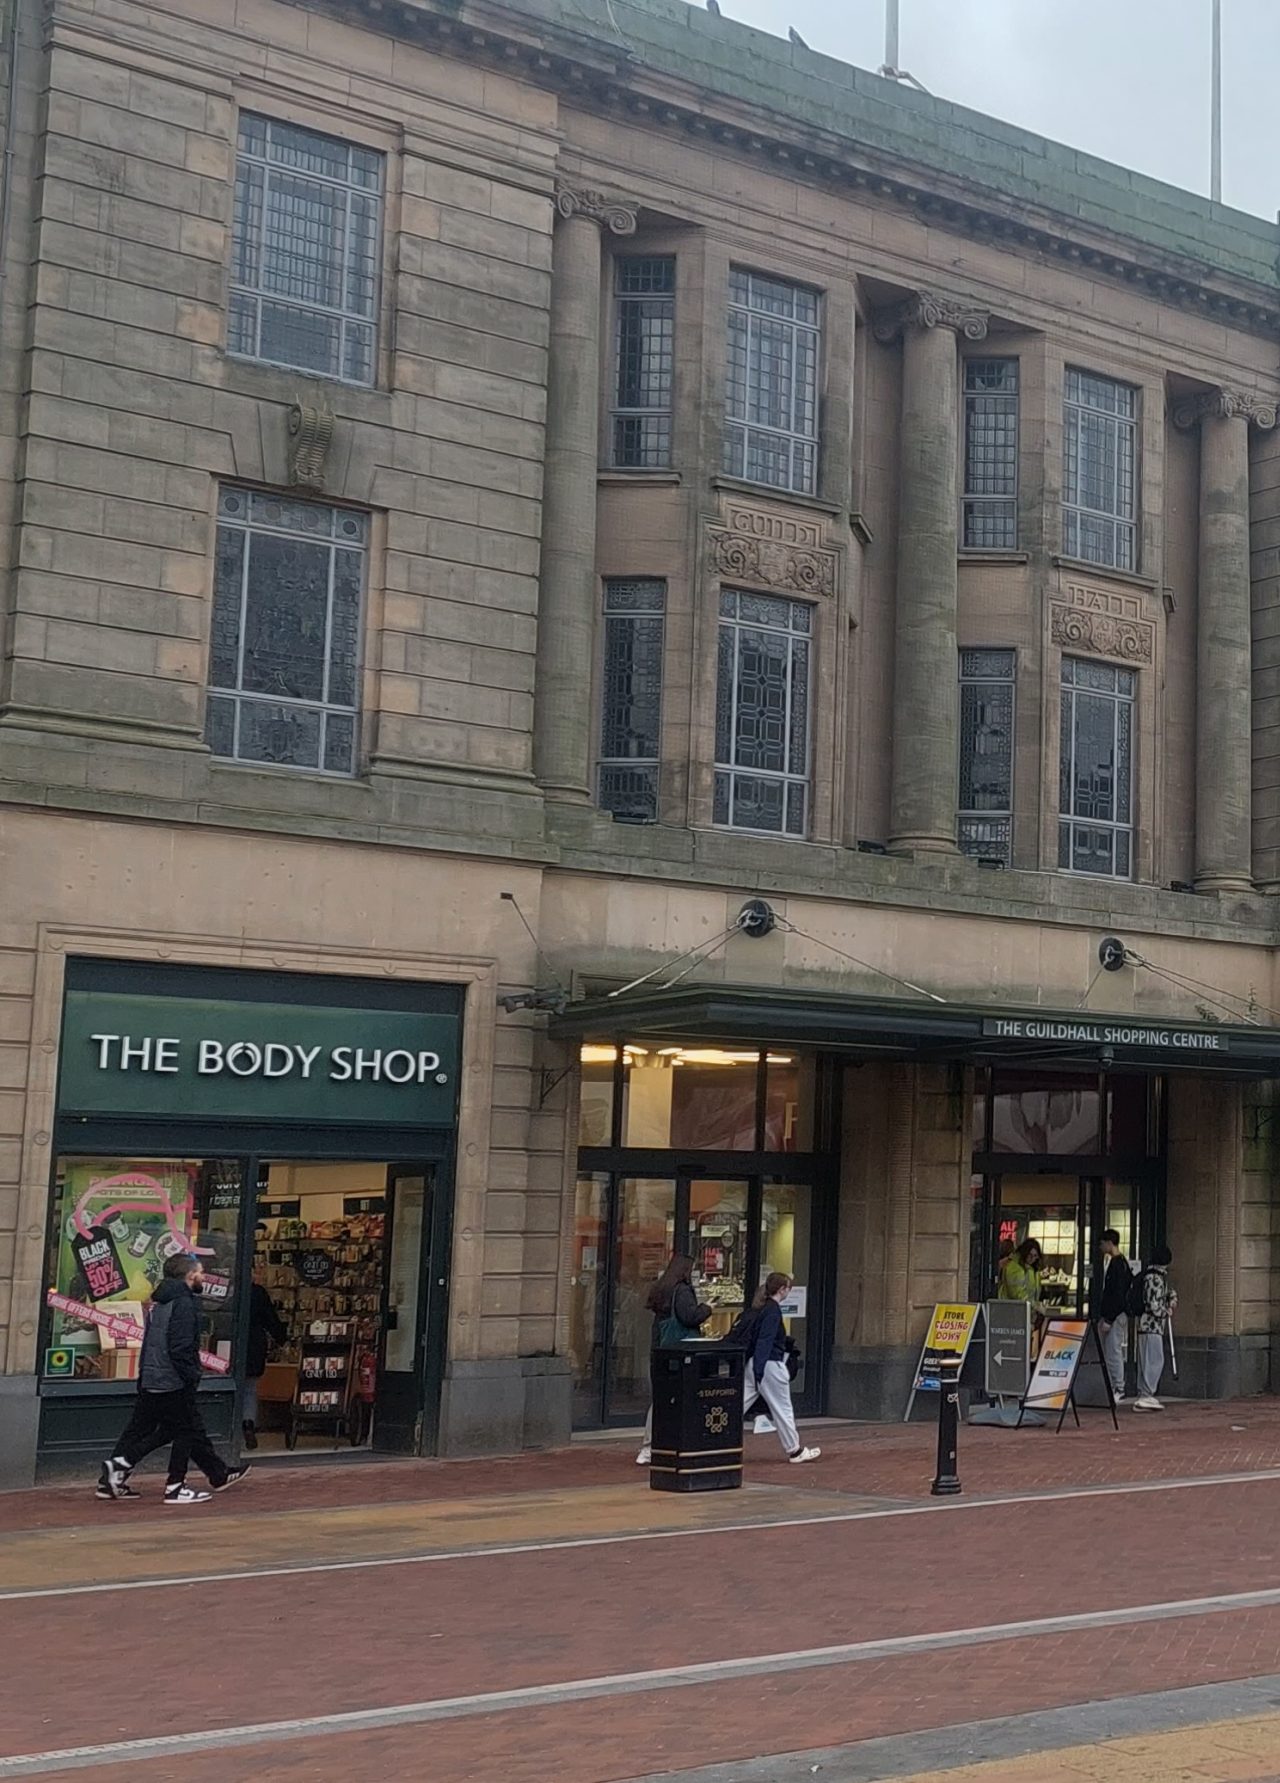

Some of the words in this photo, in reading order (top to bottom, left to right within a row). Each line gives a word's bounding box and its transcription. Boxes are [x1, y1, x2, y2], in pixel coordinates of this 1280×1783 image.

[734, 511, 811, 546] GUILD
[996, 1021, 1021, 1037] THE
[1026, 1022, 1100, 1042] GUILDHALL
[1104, 1027, 1169, 1047] SHOPPING
[1172, 1032, 1219, 1049] CENTRE
[91, 1034, 180, 1073] THE
[197, 1040, 322, 1078] BODY
[78, 1239, 111, 1261] BLACK
[87, 1258, 120, 1289] 50%
[92, 1278, 124, 1298] OFF
[935, 1320, 969, 1332] CLOSING
[943, 1311, 965, 1320] STORE
[935, 1331, 960, 1342] DOWN
[1044, 1350, 1075, 1361] BLACK
